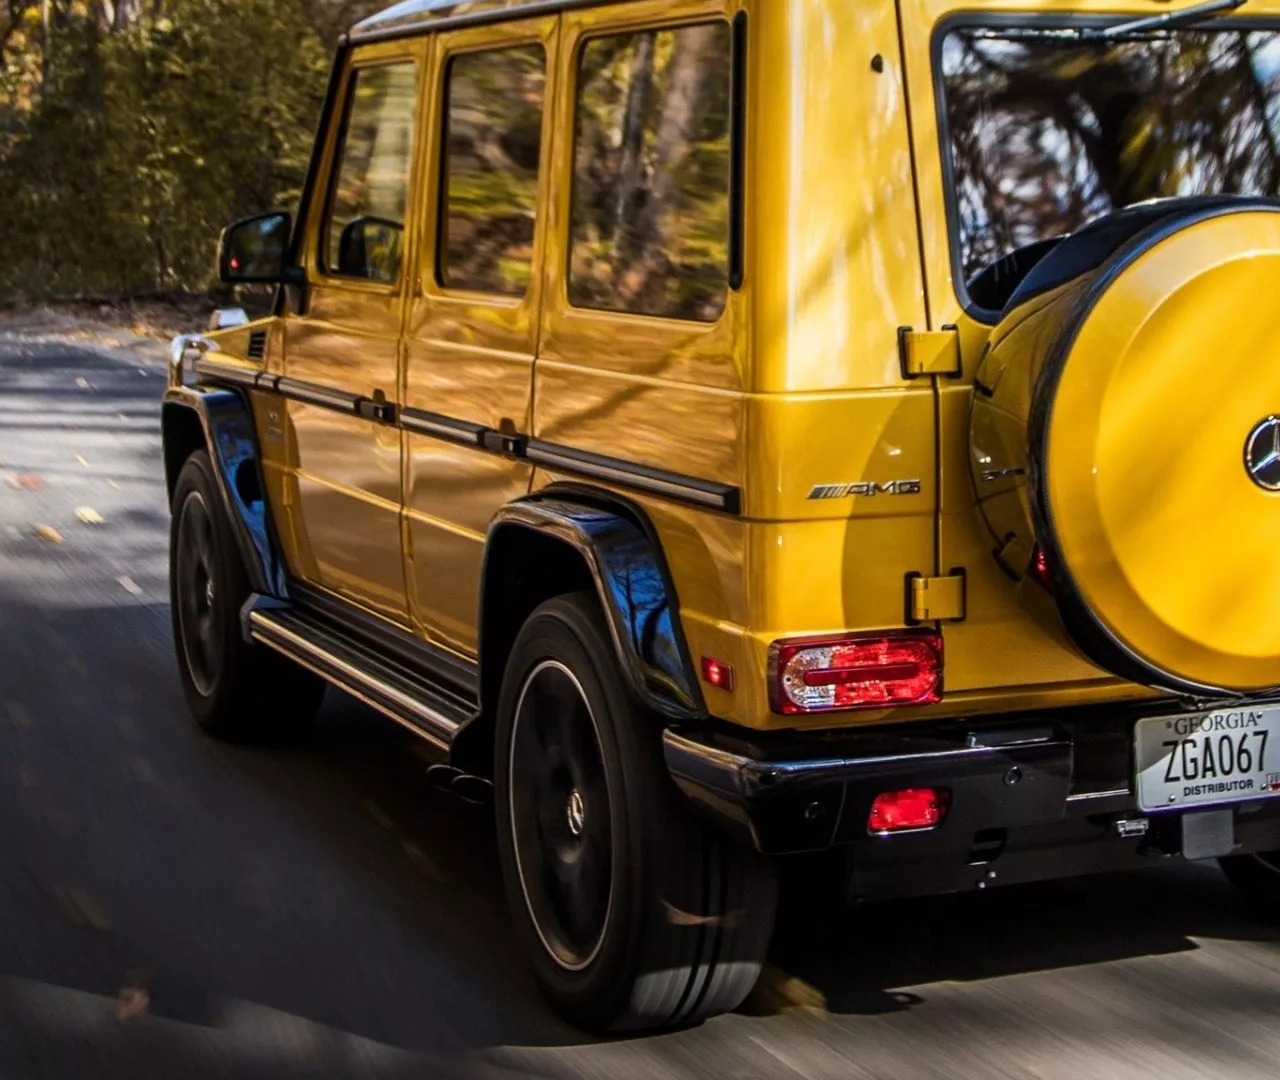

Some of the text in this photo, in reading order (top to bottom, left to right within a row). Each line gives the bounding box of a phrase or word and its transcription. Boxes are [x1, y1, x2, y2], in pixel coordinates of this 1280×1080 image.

[843, 479, 921, 497] AMG
[1174, 711, 1258, 735] GEORGIA
[1162, 730, 1268, 783] ZGA067
[1183, 779, 1254, 797] DISTRIBUTOR
